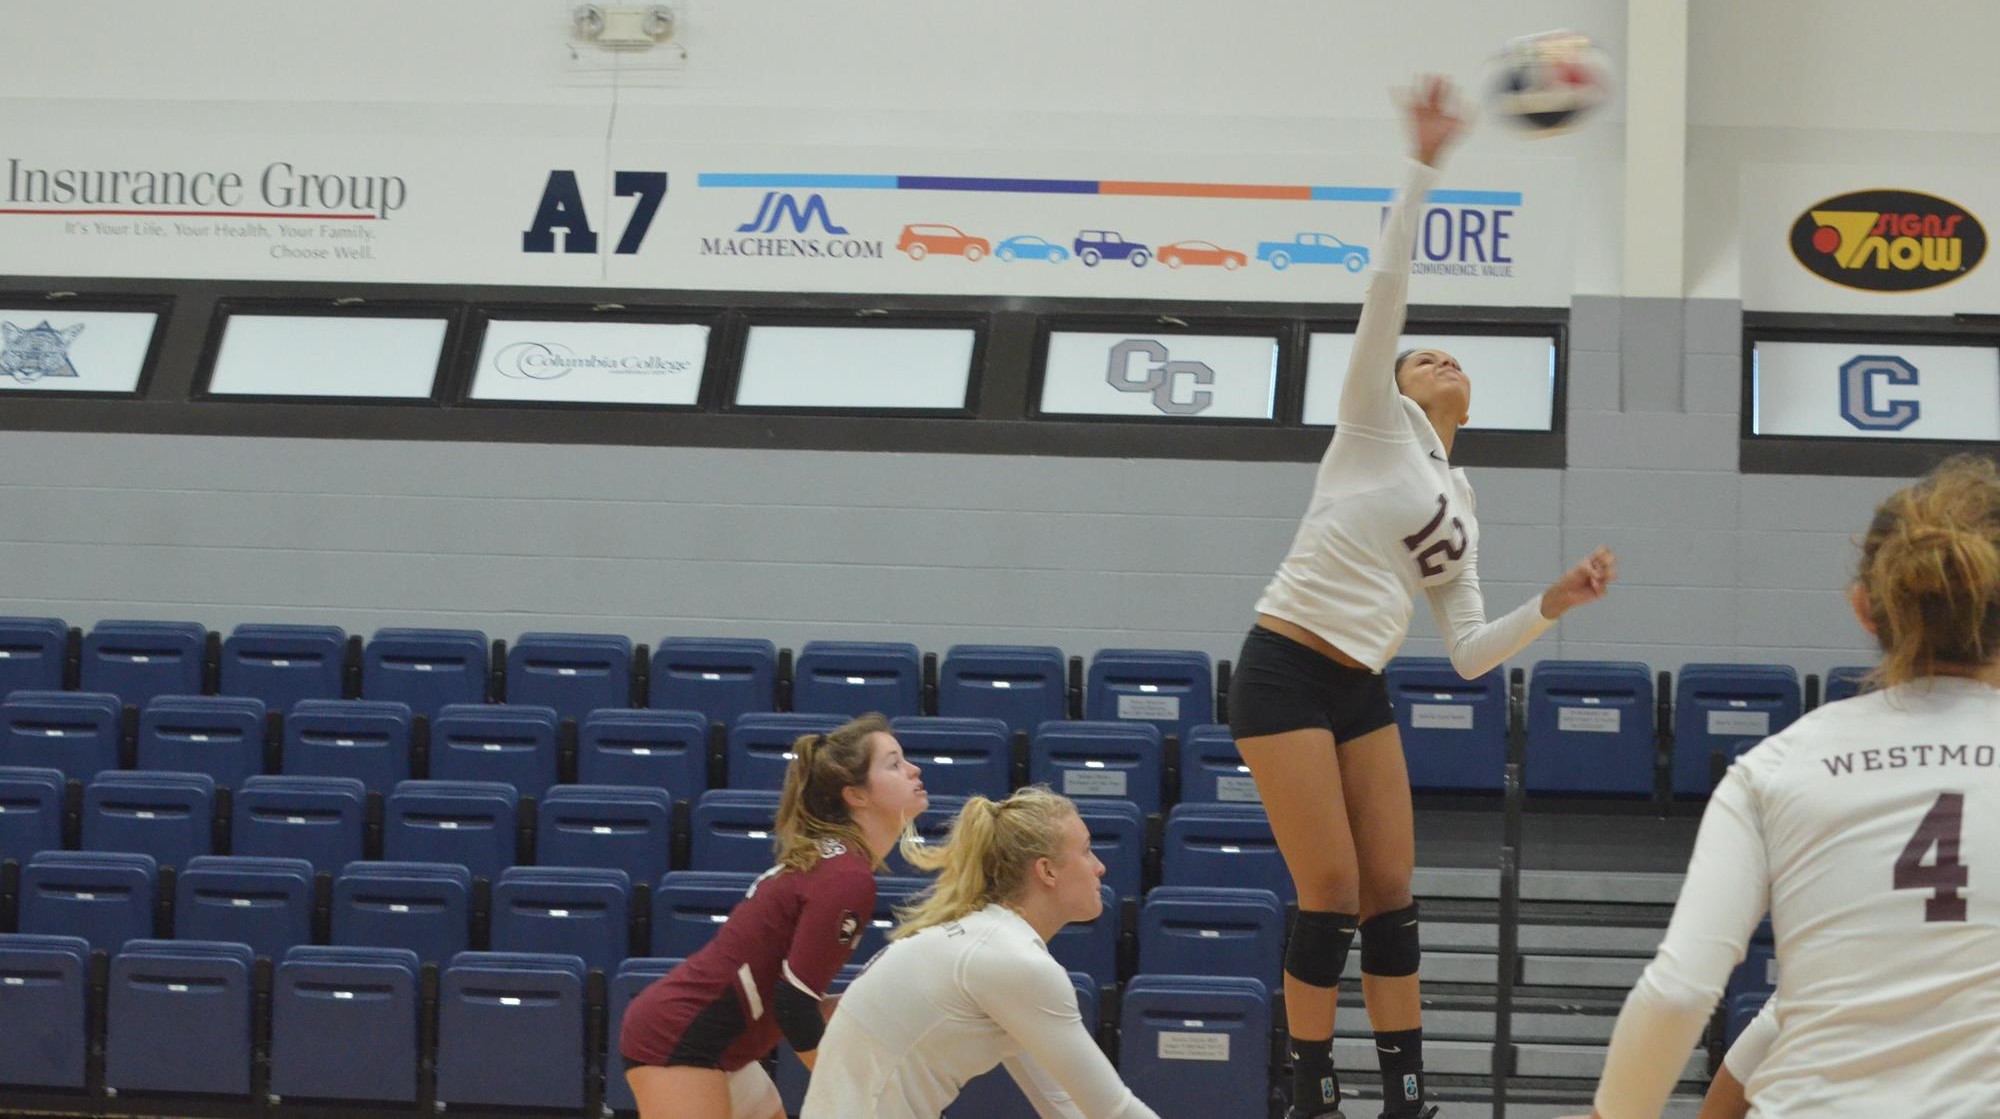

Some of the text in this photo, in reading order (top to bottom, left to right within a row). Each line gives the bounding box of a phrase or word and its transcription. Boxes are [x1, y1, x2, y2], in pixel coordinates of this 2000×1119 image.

[7, 158, 407, 220] Insurance Group
[94, 222, 129, 236] Your
[174, 222, 209, 237] Your
[278, 224, 314, 238] Your
[269, 244, 330, 259] Choose
[700, 237, 884, 258] MACHENS.COM
[1380, 206, 1513, 263] ORE
[525, 354, 692, 373] Columbia College
[1839, 355, 1920, 431] C
[1403, 493, 1467, 577] 12
[1821, 744, 2000, 777] WESTMO
[1893, 792, 1969, 922] 4
